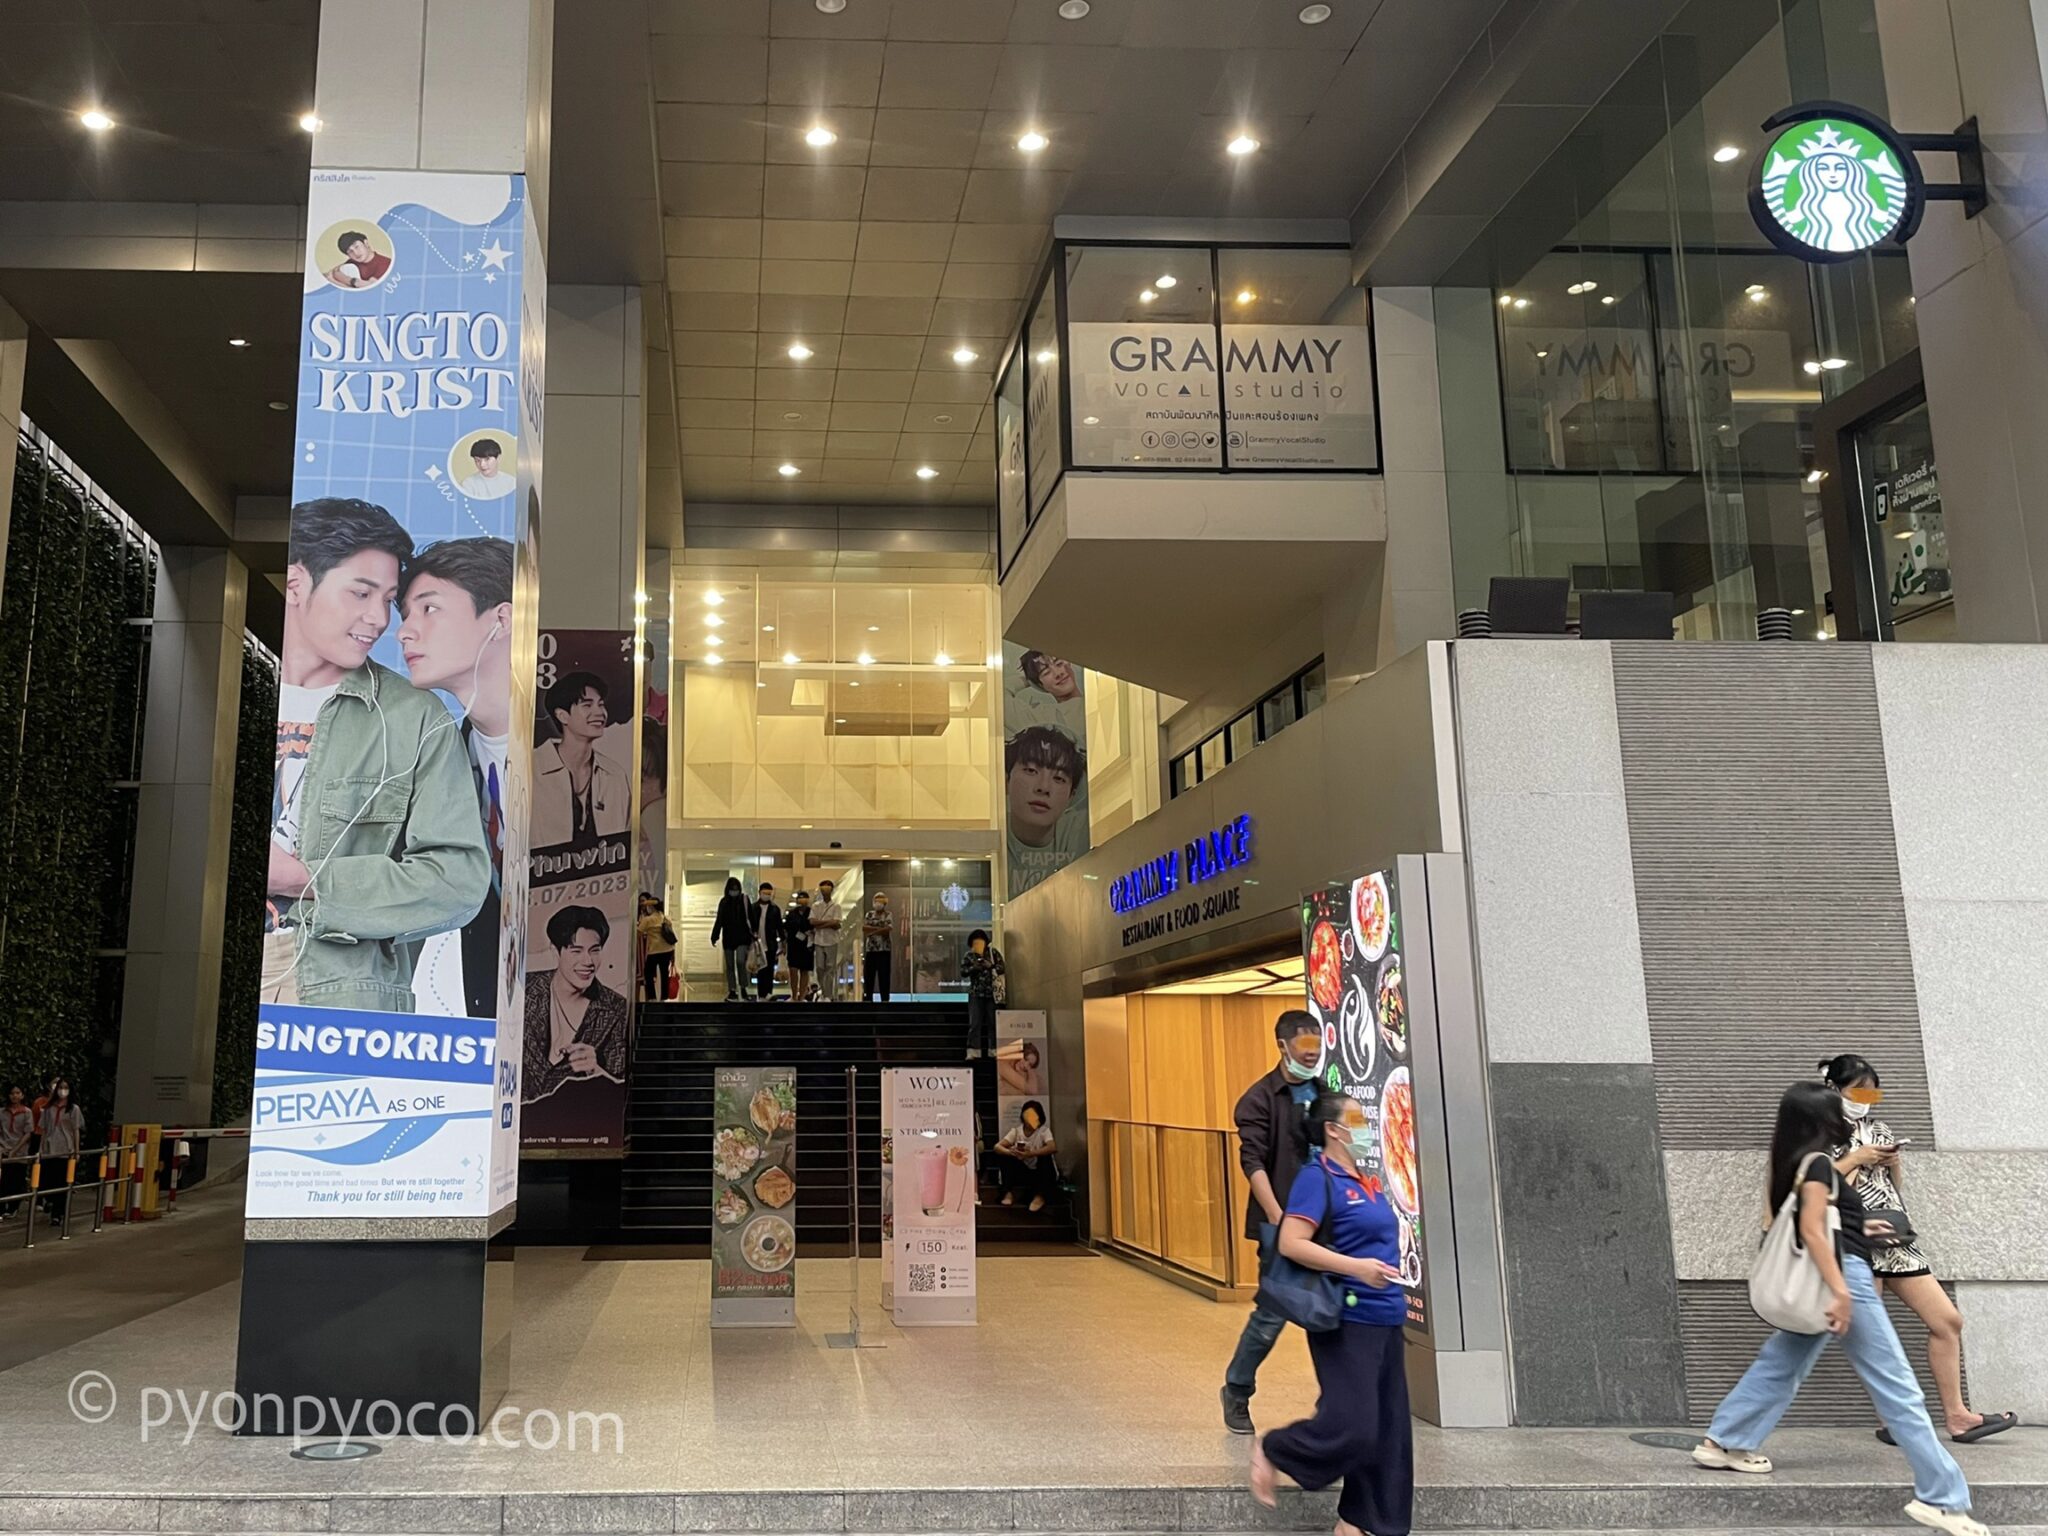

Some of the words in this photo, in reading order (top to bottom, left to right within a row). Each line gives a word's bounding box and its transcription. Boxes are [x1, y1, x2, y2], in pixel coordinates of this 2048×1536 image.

[309, 311, 508, 363] SINGTO
[1109, 336, 1342, 374] GRAMMY
[313, 365, 515, 418] KRIST
[1235, 380, 1344, 399] studio
[1021, 851, 1077, 867] HAPPY
[1109, 848, 1180, 916] GRAMMY
[1184, 812, 1252, 885] PLACE
[1122, 914, 1165, 947] RESTAURANT
[1166, 912, 1173, 931] &
[1174, 902, 1200, 930] FOOD
[1202, 886, 1240, 921] SQUARE
[257, 1021, 497, 1067] SINGTOKRIST
[909, 1076, 956, 1090] WOW
[1344, 1085, 1376, 1100] SEAFOOD
[256, 1086, 379, 1126] PERAYA
[386, 1098, 408, 1113] AS
[413, 1095, 446, 1112] ONE
[295, 1180, 313, 1188] good
[434, 1178, 465, 1187] together
[307, 1191, 340, 1202] Thank
[342, 1193, 363, 1204] you
[366, 1190, 381, 1201] for
[384, 1190, 405, 1201] still
[407, 1190, 437, 1204] being
[440, 1190, 464, 1201] here
[922, 1241, 942, 1253] 150
